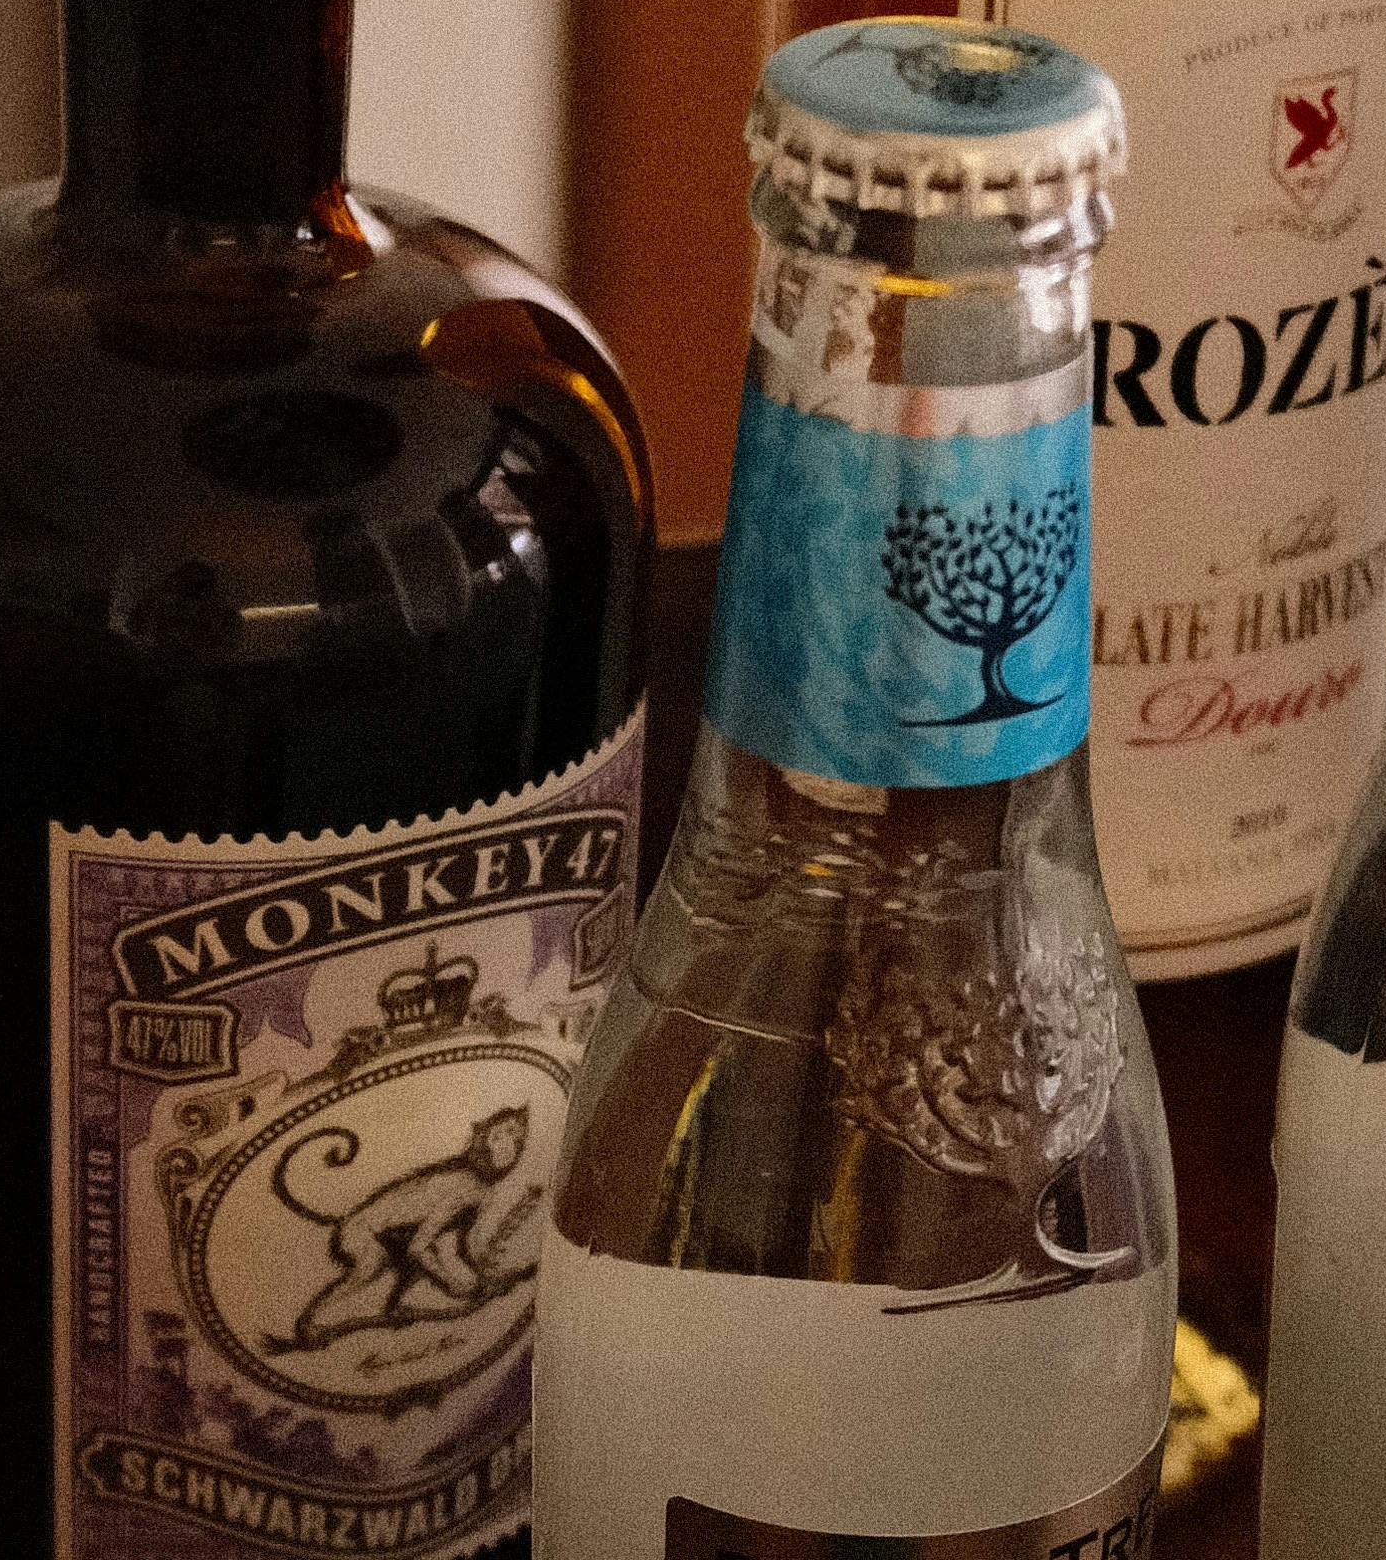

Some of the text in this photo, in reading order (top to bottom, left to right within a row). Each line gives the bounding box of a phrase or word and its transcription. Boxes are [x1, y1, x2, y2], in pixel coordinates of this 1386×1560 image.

[1094, 602, 1214, 666] LATE
[148, 828, 619, 987] MONKEY 47
[120, 1447, 479, 1544] SCHWARZWALD
